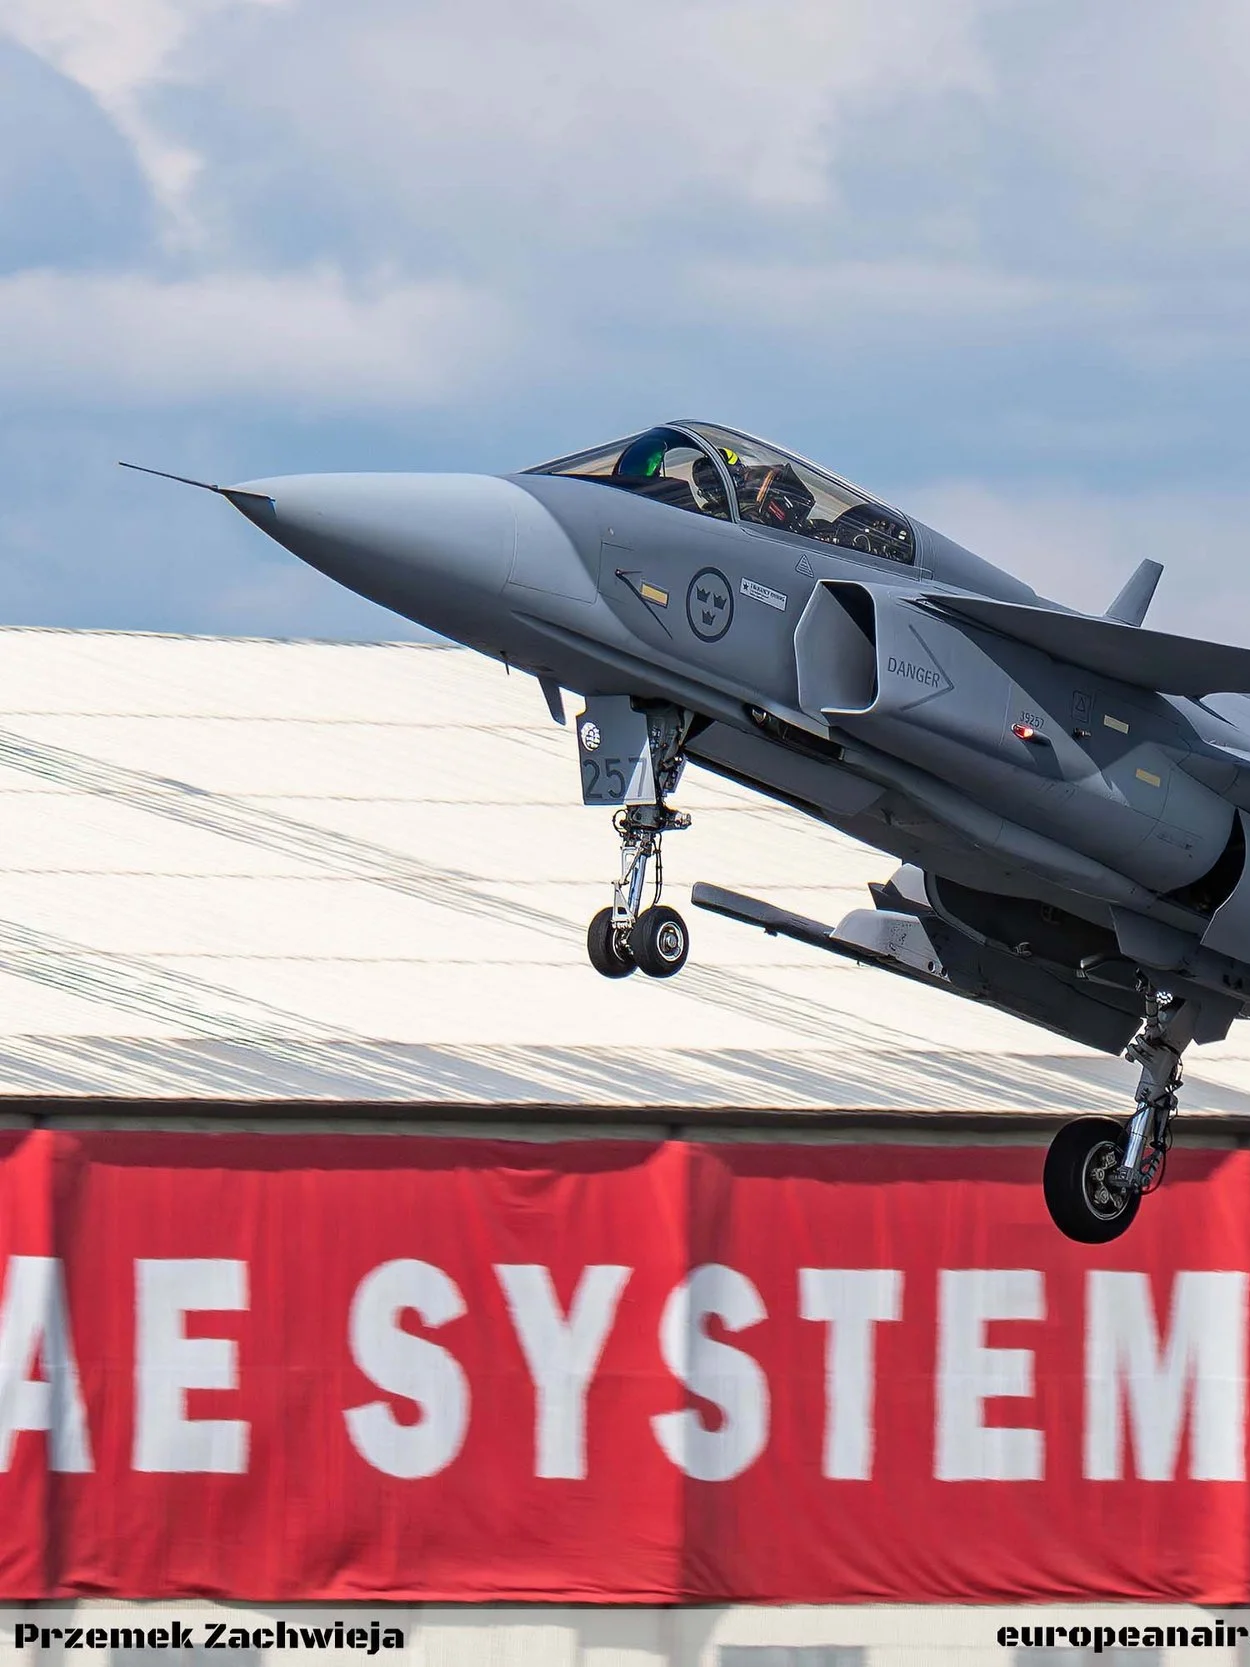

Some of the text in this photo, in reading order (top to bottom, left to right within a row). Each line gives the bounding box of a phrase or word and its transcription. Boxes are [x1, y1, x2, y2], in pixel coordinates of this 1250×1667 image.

[887, 656, 940, 688] DANGER
[583, 756, 648, 799] 257
[0, 1255, 251, 1474] AE
